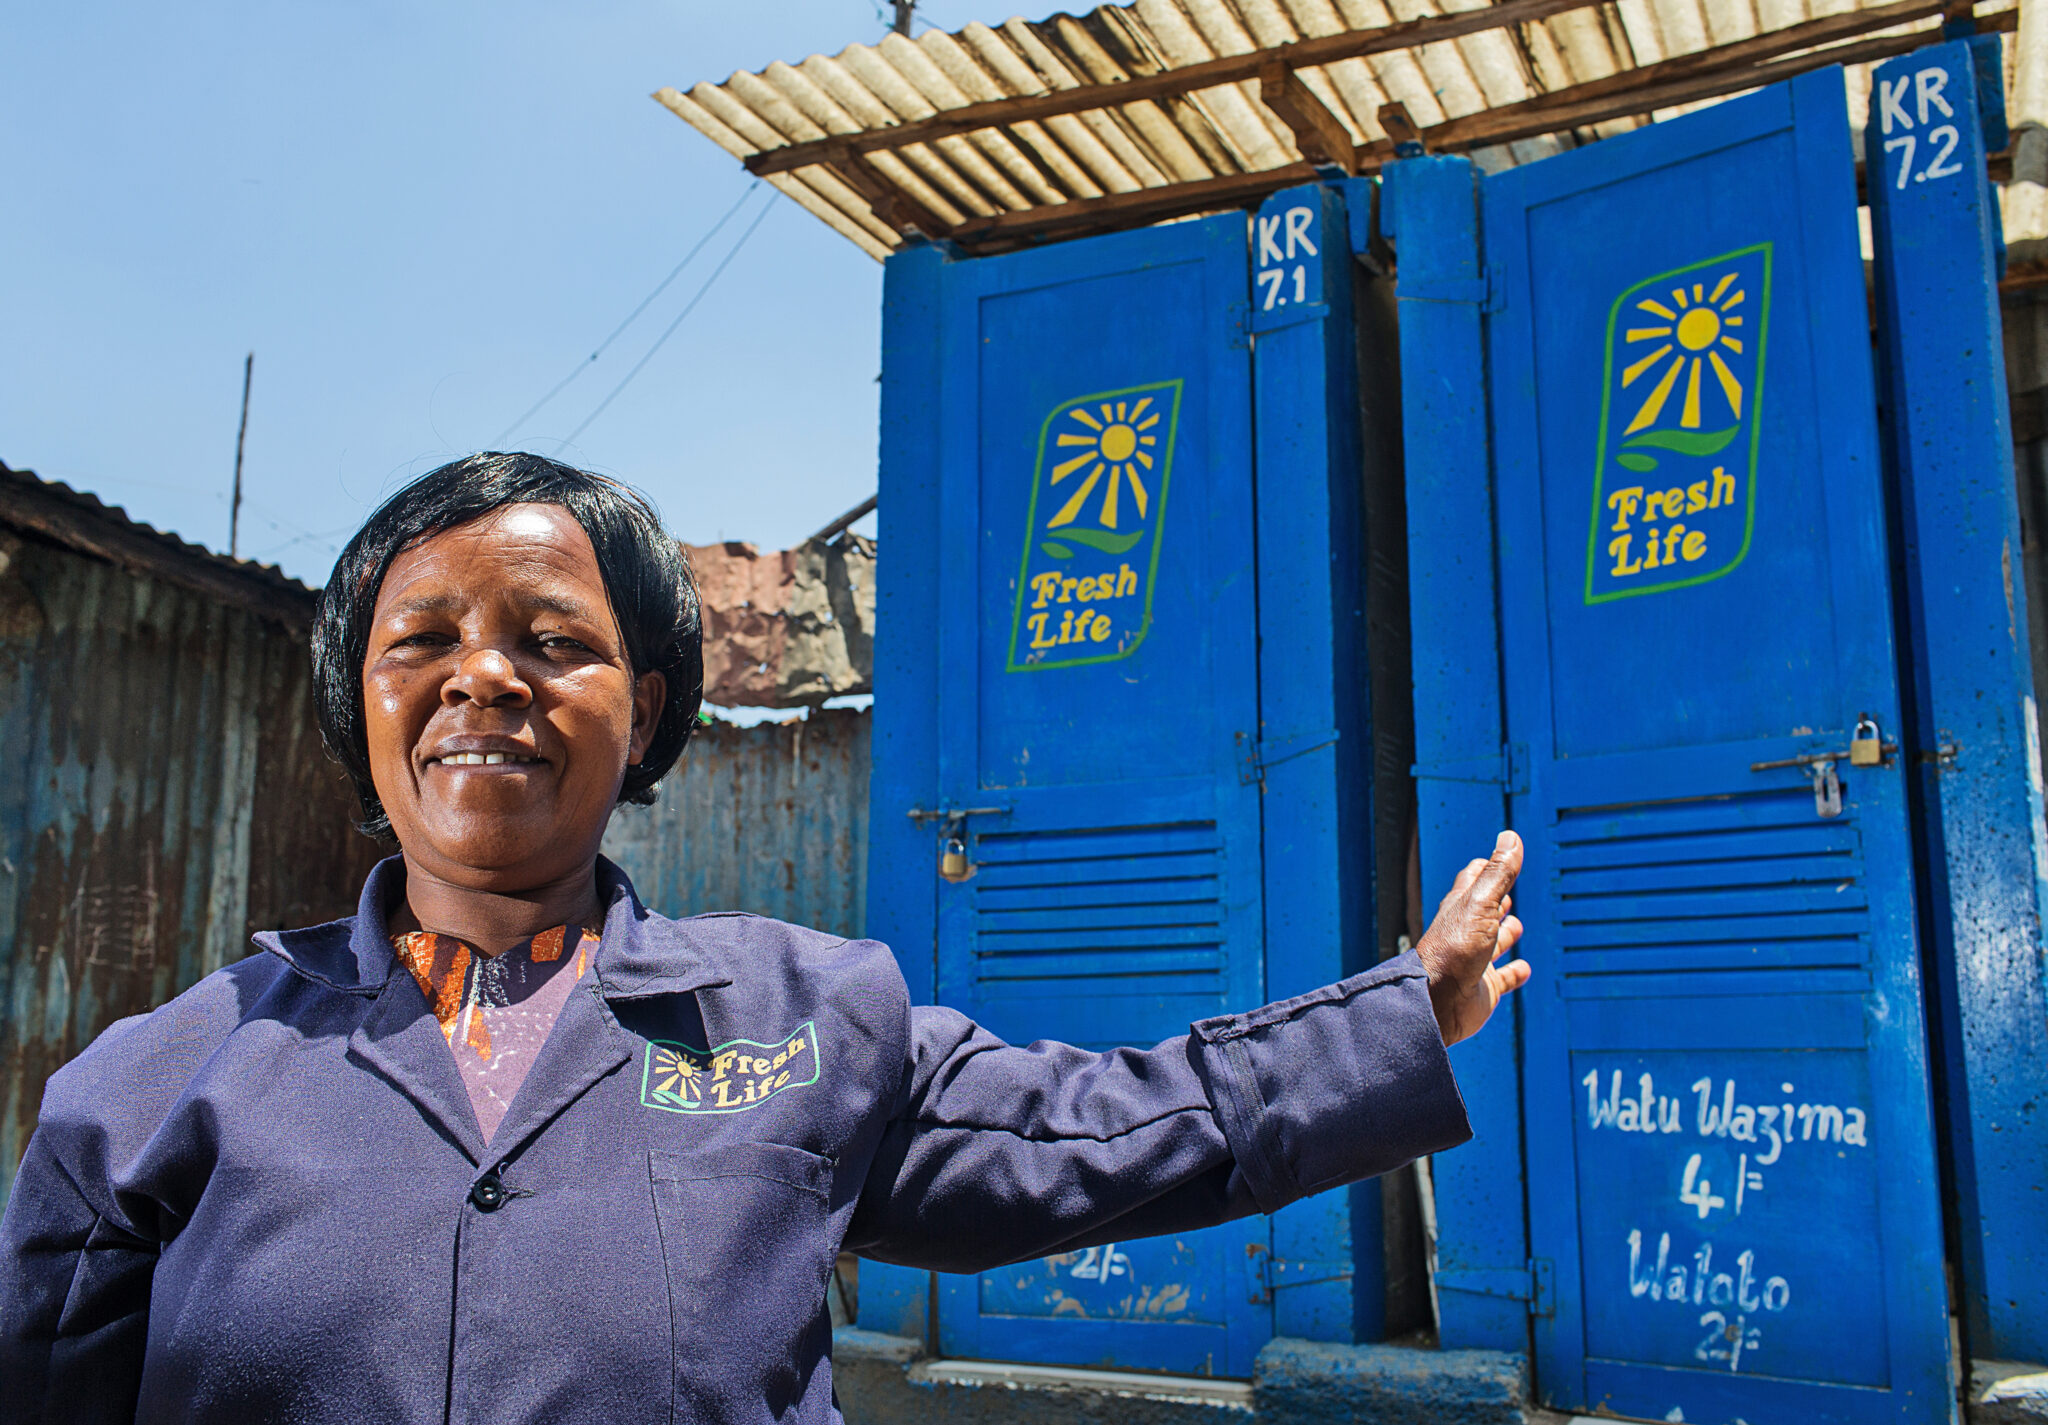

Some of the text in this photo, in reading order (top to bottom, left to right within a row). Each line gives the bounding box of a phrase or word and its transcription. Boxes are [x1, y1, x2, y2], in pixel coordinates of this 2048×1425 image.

[1881, 66, 1954, 131] KR
[1884, 126, 1962, 190] 7.2
[1258, 206, 1318, 268] KR
[1257, 265, 1307, 310] 7.1
[1608, 467, 1735, 531] Fresh
[1608, 524, 1707, 577] Life
[1030, 564, 1137, 609] Fresh
[1028, 609, 1111, 648] Life
[708, 1037, 807, 1081] Fresh
[710, 1070, 791, 1107] Life
[1582, 1068, 1867, 1165] Watu Wazima
[1626, 1228, 1791, 1312] Watoto
